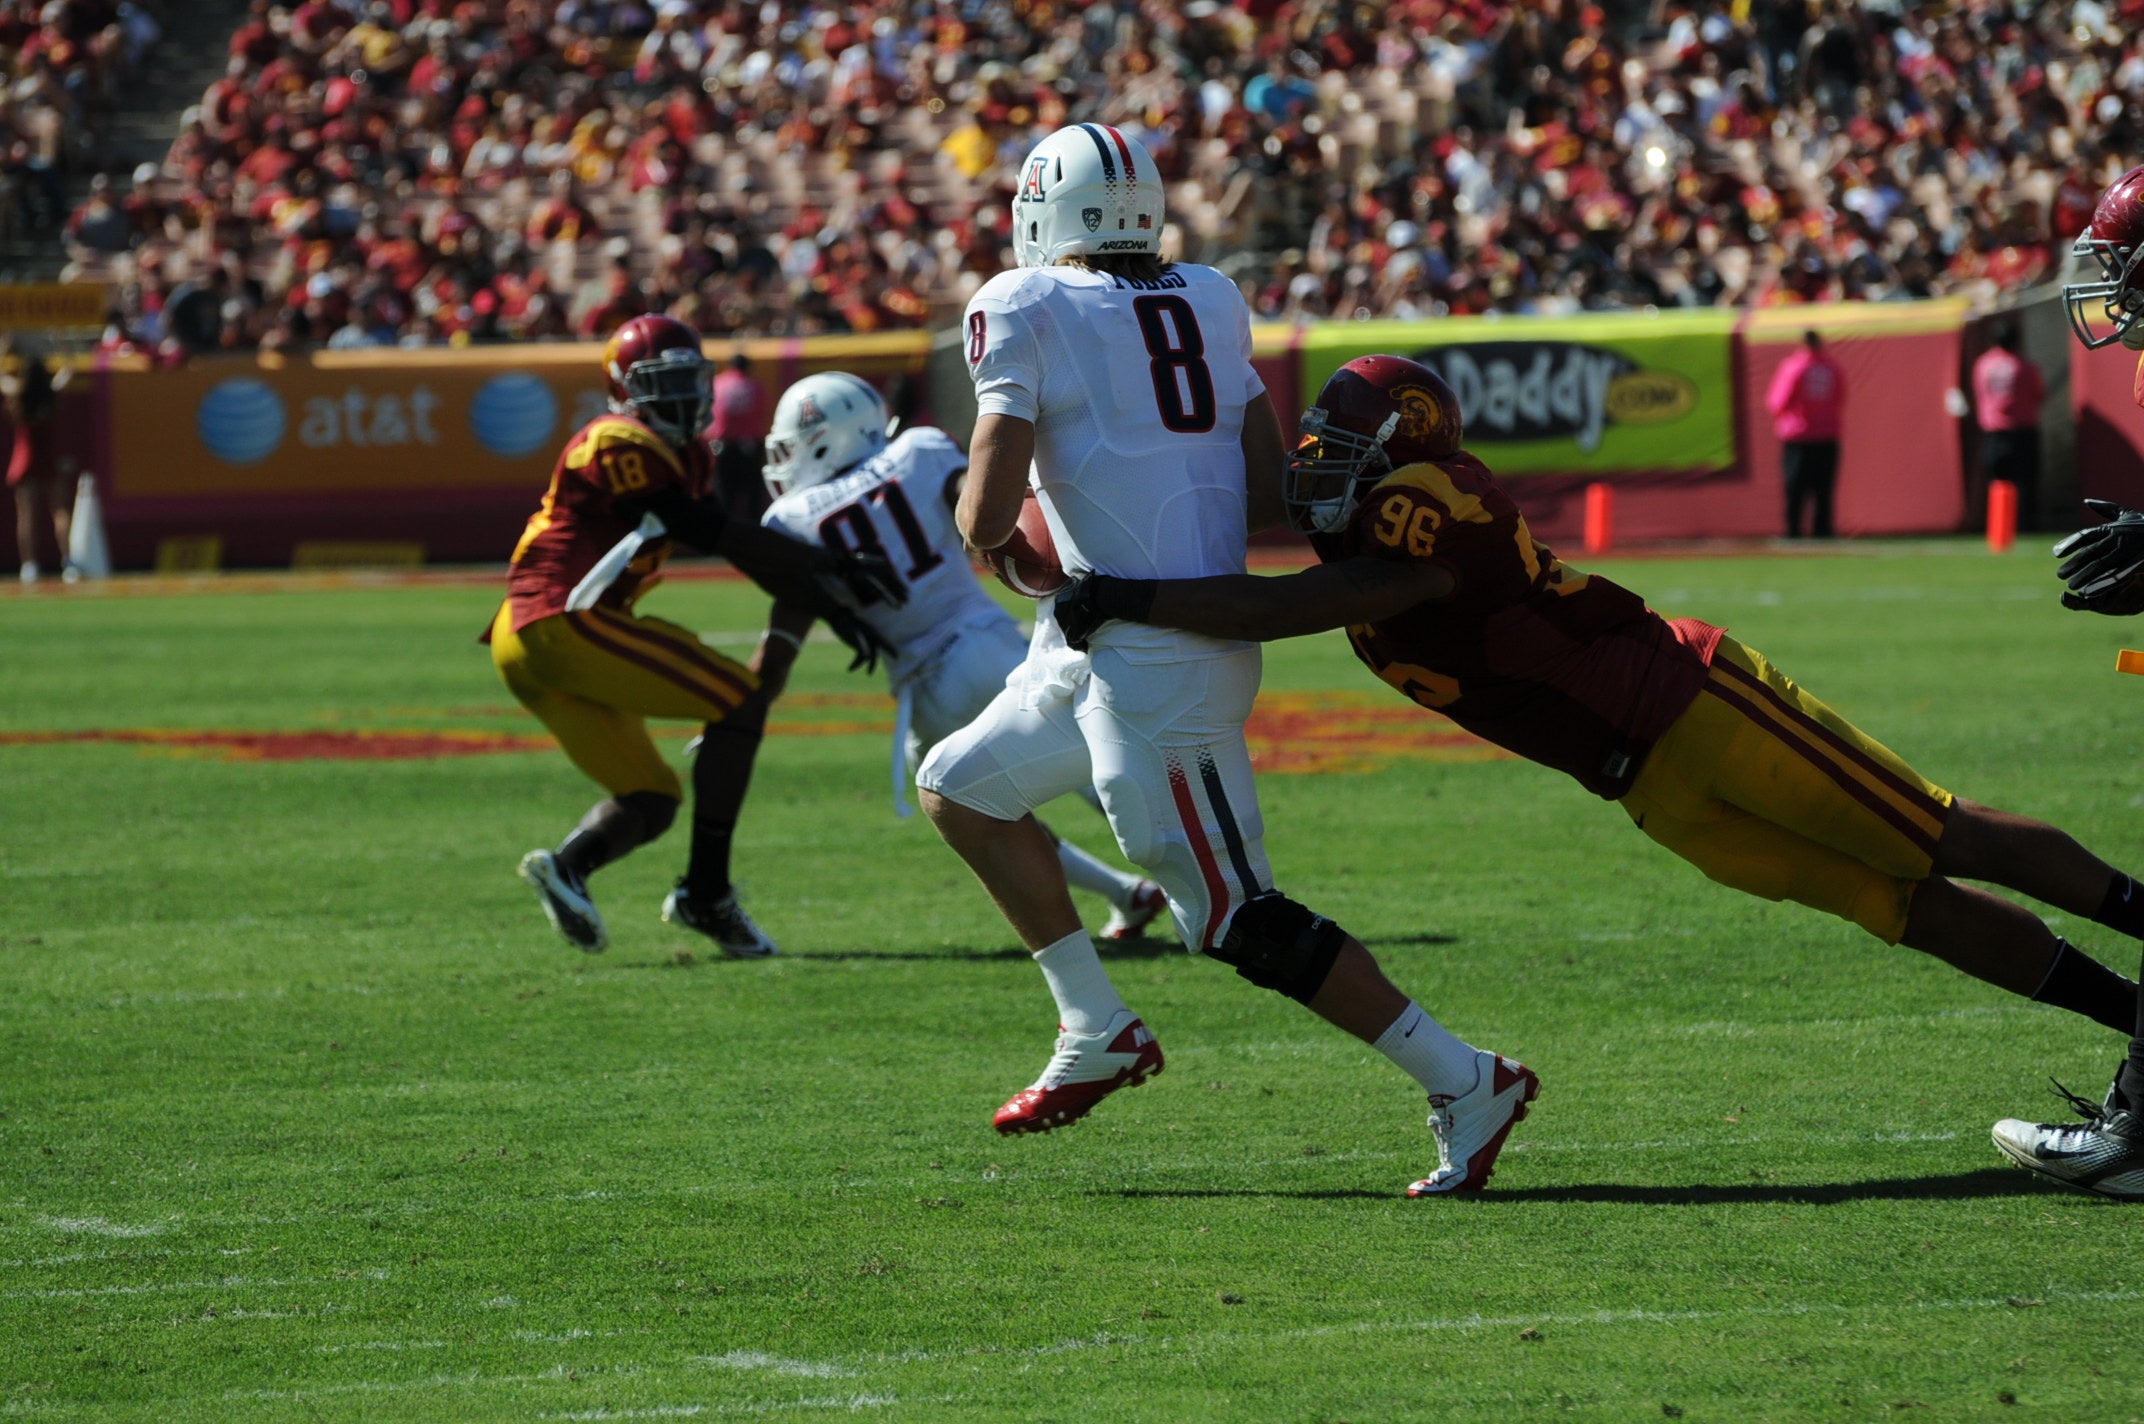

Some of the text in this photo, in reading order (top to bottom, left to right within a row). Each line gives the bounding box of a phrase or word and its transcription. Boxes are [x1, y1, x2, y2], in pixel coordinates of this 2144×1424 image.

[1097, 240, 1147, 251] ARIZONA
[1118, 218, 1125, 230] 8
[968, 310, 986, 364] 8
[1132, 295, 1216, 434] 8
[299, 385, 440, 447] at&t
[1445, 346, 1616, 452] Daddy
[601, 451, 649, 495] 18
[1374, 494, 1442, 557] 96
